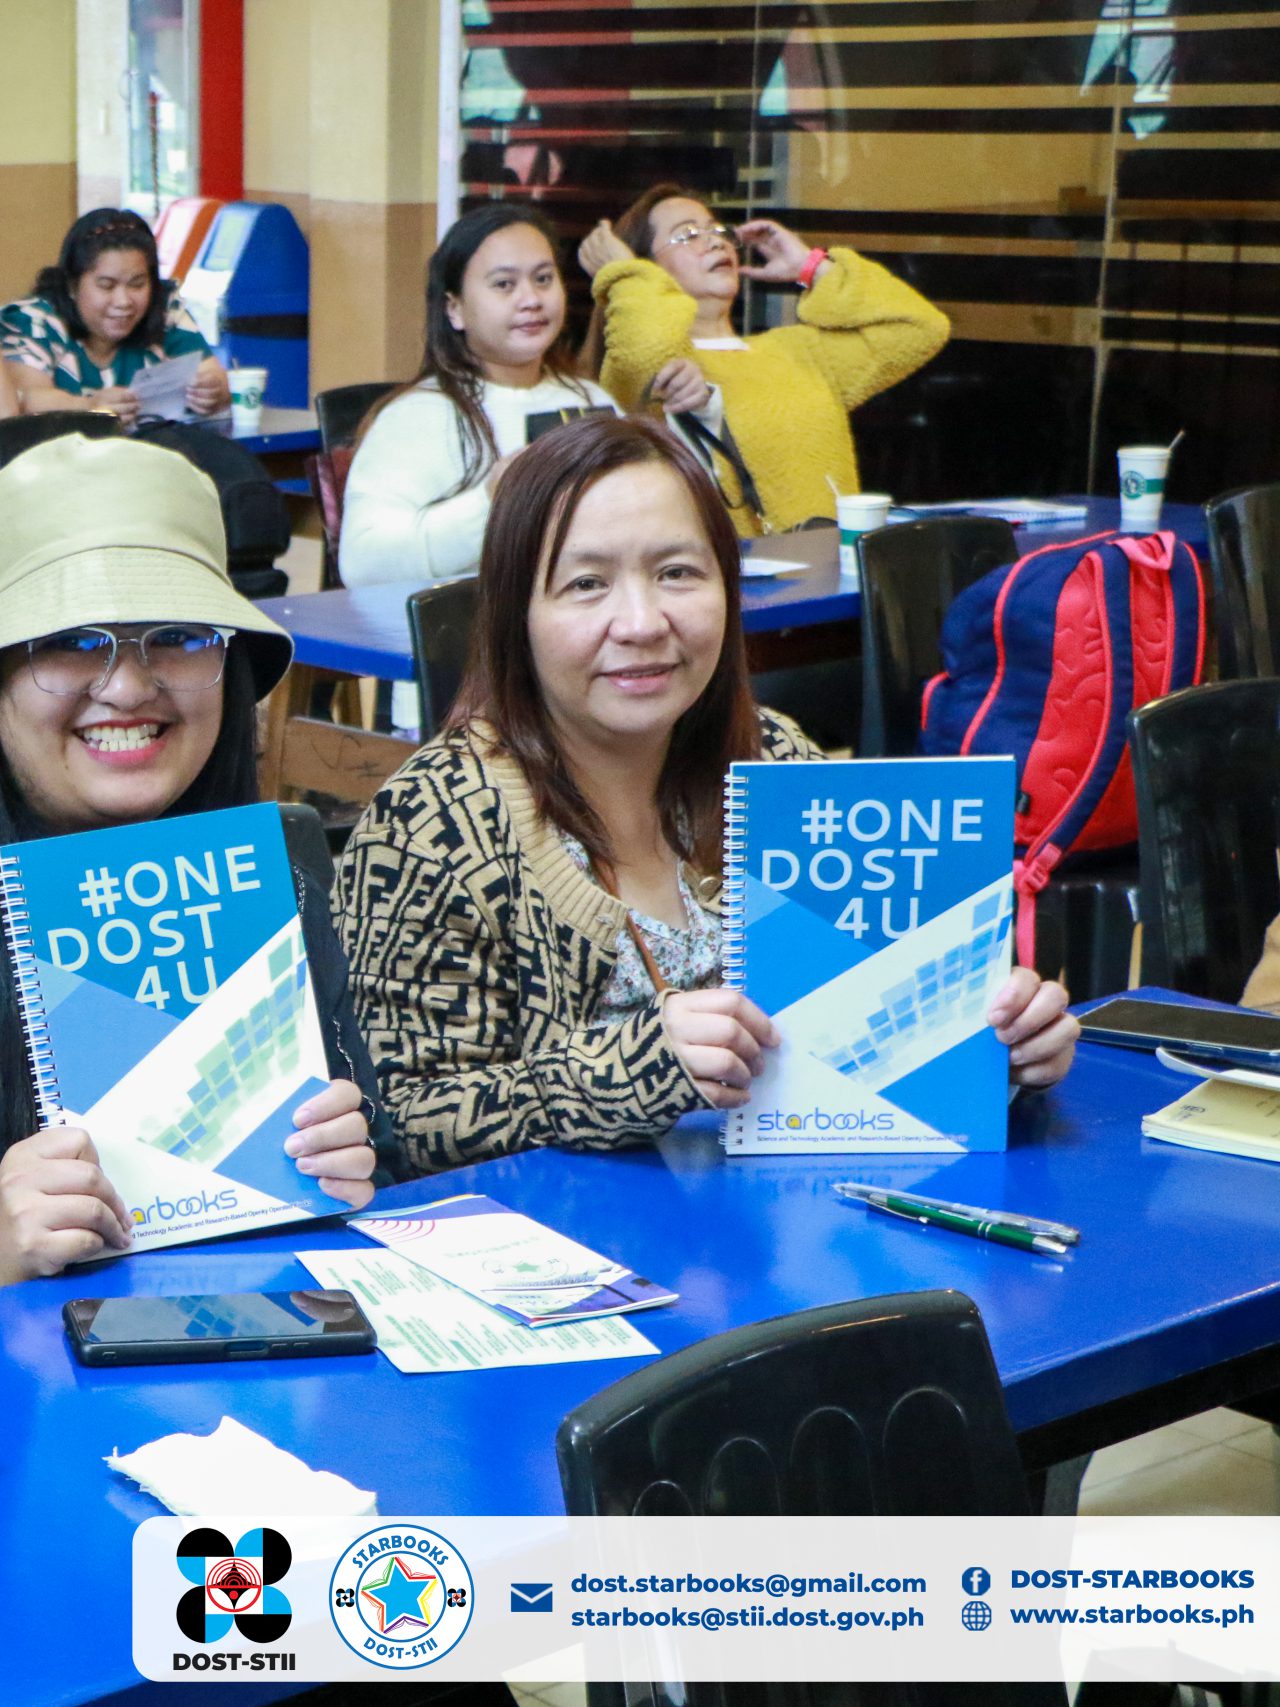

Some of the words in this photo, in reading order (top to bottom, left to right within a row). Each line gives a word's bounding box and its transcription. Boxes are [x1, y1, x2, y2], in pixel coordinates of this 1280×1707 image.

[801, 799, 984, 845] #ONE
[78, 844, 261, 918] #ONE
[761, 848, 939, 892] DOST
[48, 902, 222, 972] DOST
[833, 896, 919, 940] 4U
[133, 956, 218, 1010] 4U
[757, 1107, 894, 1131] starbooks
[130, 1188, 238, 1225] arbooks
